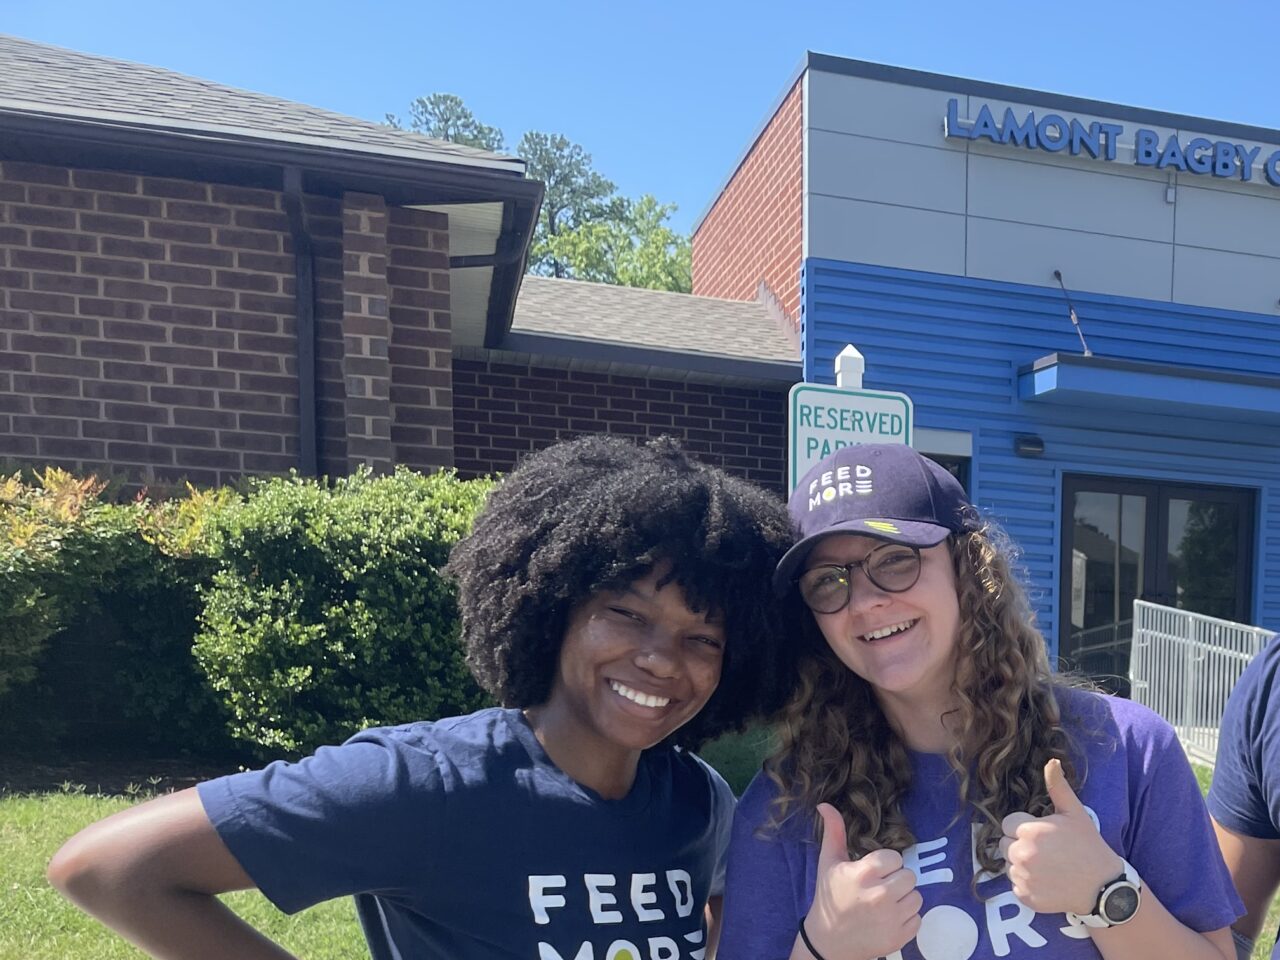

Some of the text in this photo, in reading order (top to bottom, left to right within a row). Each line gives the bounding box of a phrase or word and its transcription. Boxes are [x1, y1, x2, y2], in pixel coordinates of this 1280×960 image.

[946, 98, 1123, 160] LAMONT
[1135, 129, 1260, 182] BAGBY
[800, 404, 903, 436] RESERVED
[809, 465, 872, 494] FEED
[528, 869, 694, 924] FEED
